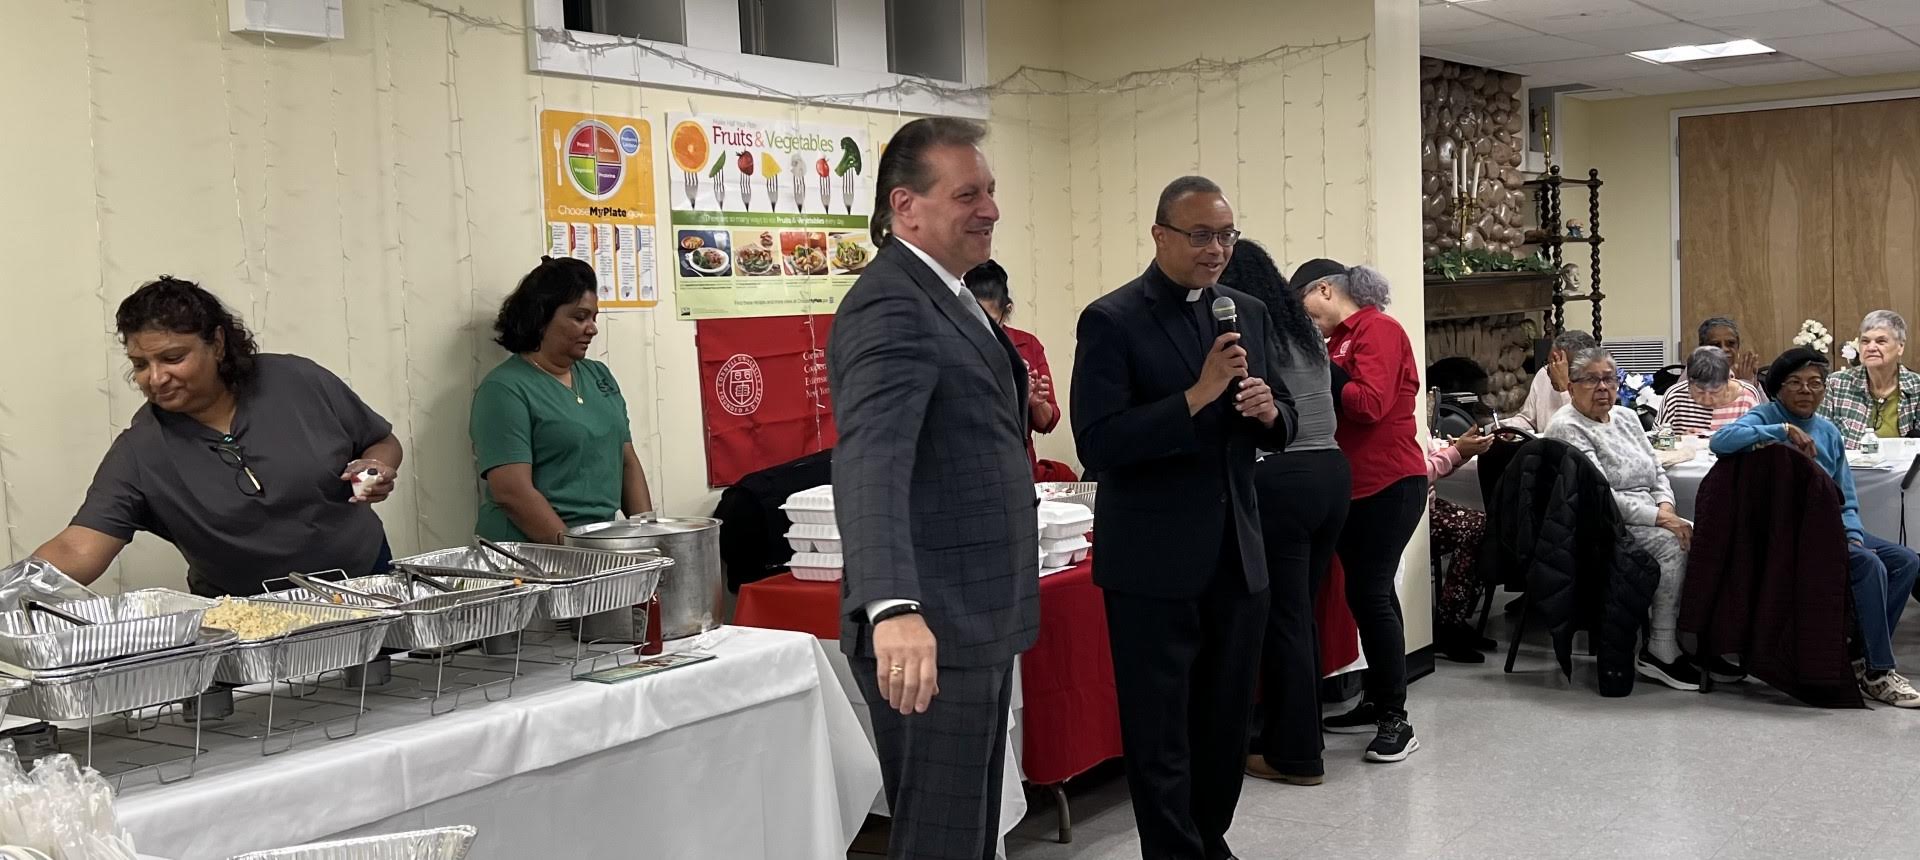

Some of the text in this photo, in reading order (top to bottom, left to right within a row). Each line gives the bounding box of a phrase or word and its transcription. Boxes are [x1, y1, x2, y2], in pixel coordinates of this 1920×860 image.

[712, 125, 834, 154] Fruits & Vegetables
[776, 215, 791, 225] Fruits
